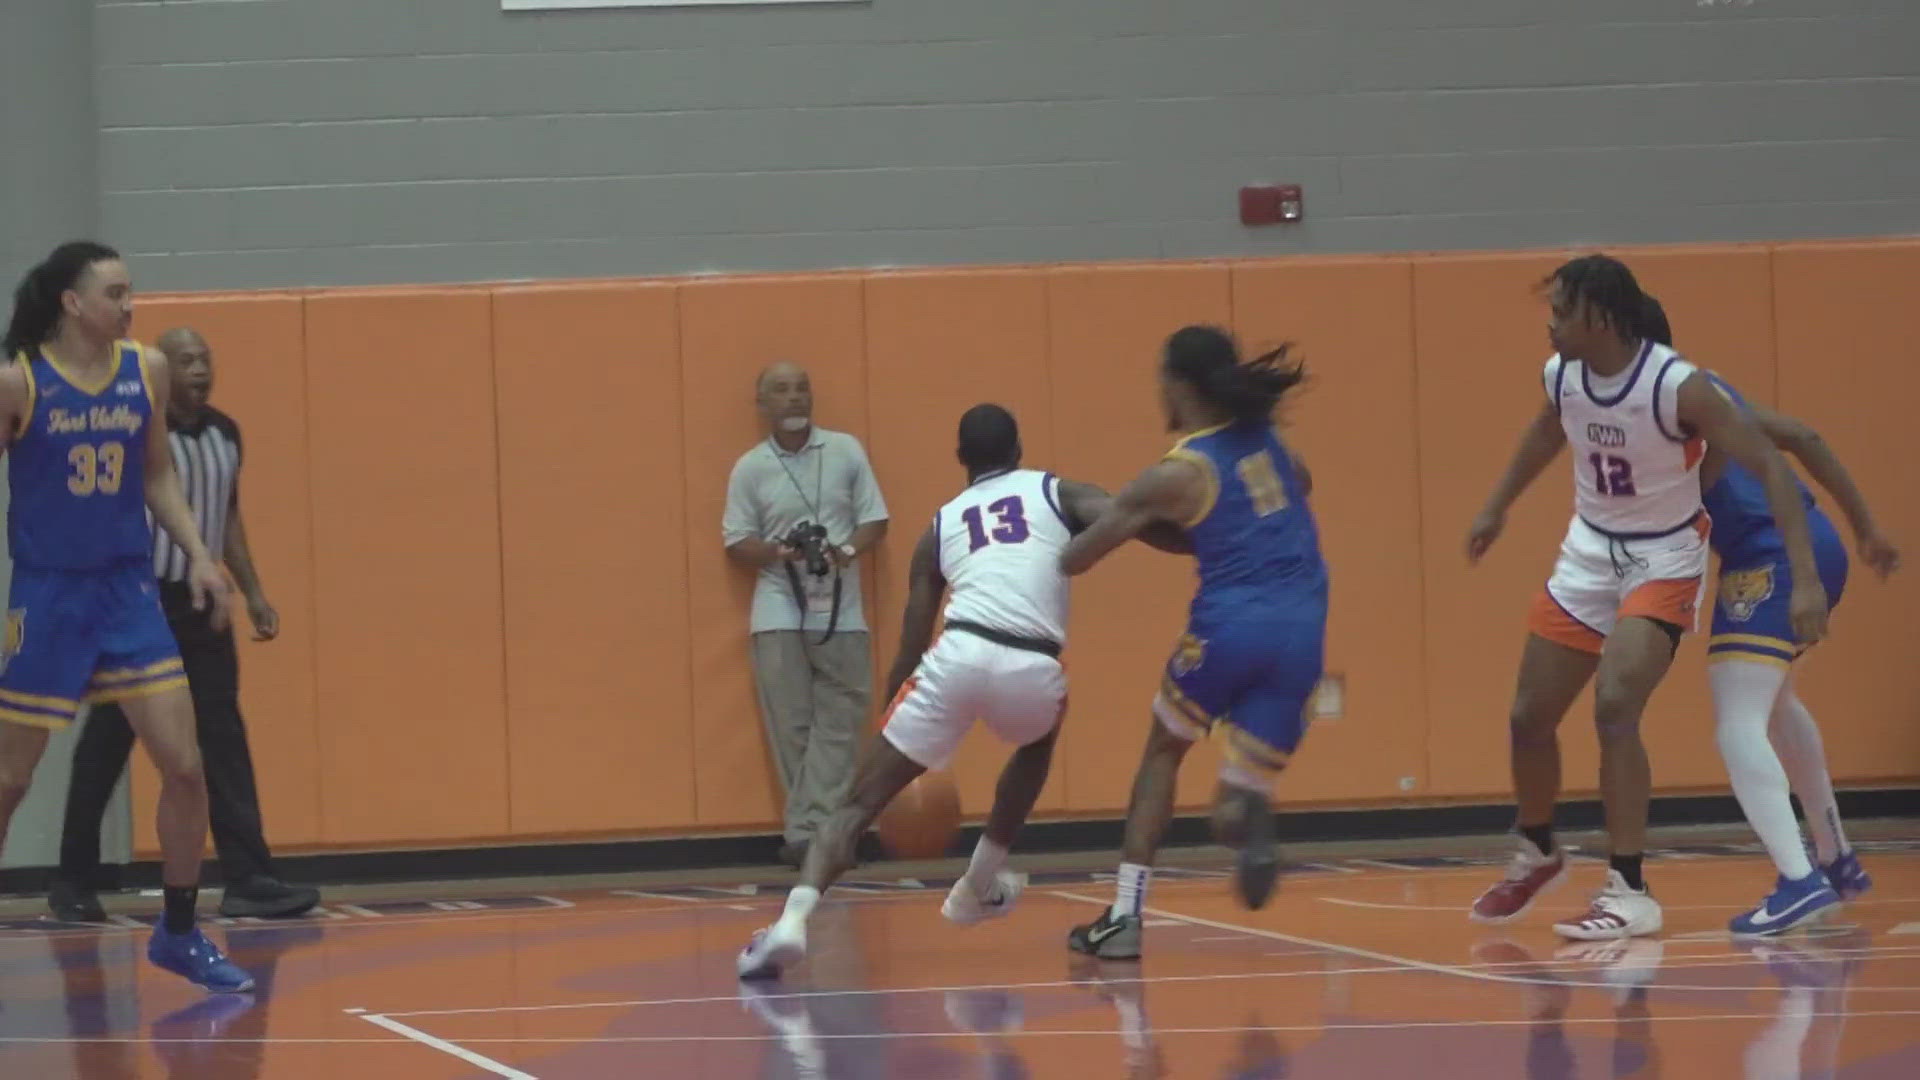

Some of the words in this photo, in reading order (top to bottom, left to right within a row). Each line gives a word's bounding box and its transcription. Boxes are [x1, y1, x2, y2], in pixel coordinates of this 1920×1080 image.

[67, 441, 124, 497] 33
[1589, 452, 1637, 497] 12
[962, 495, 1031, 554] 13
